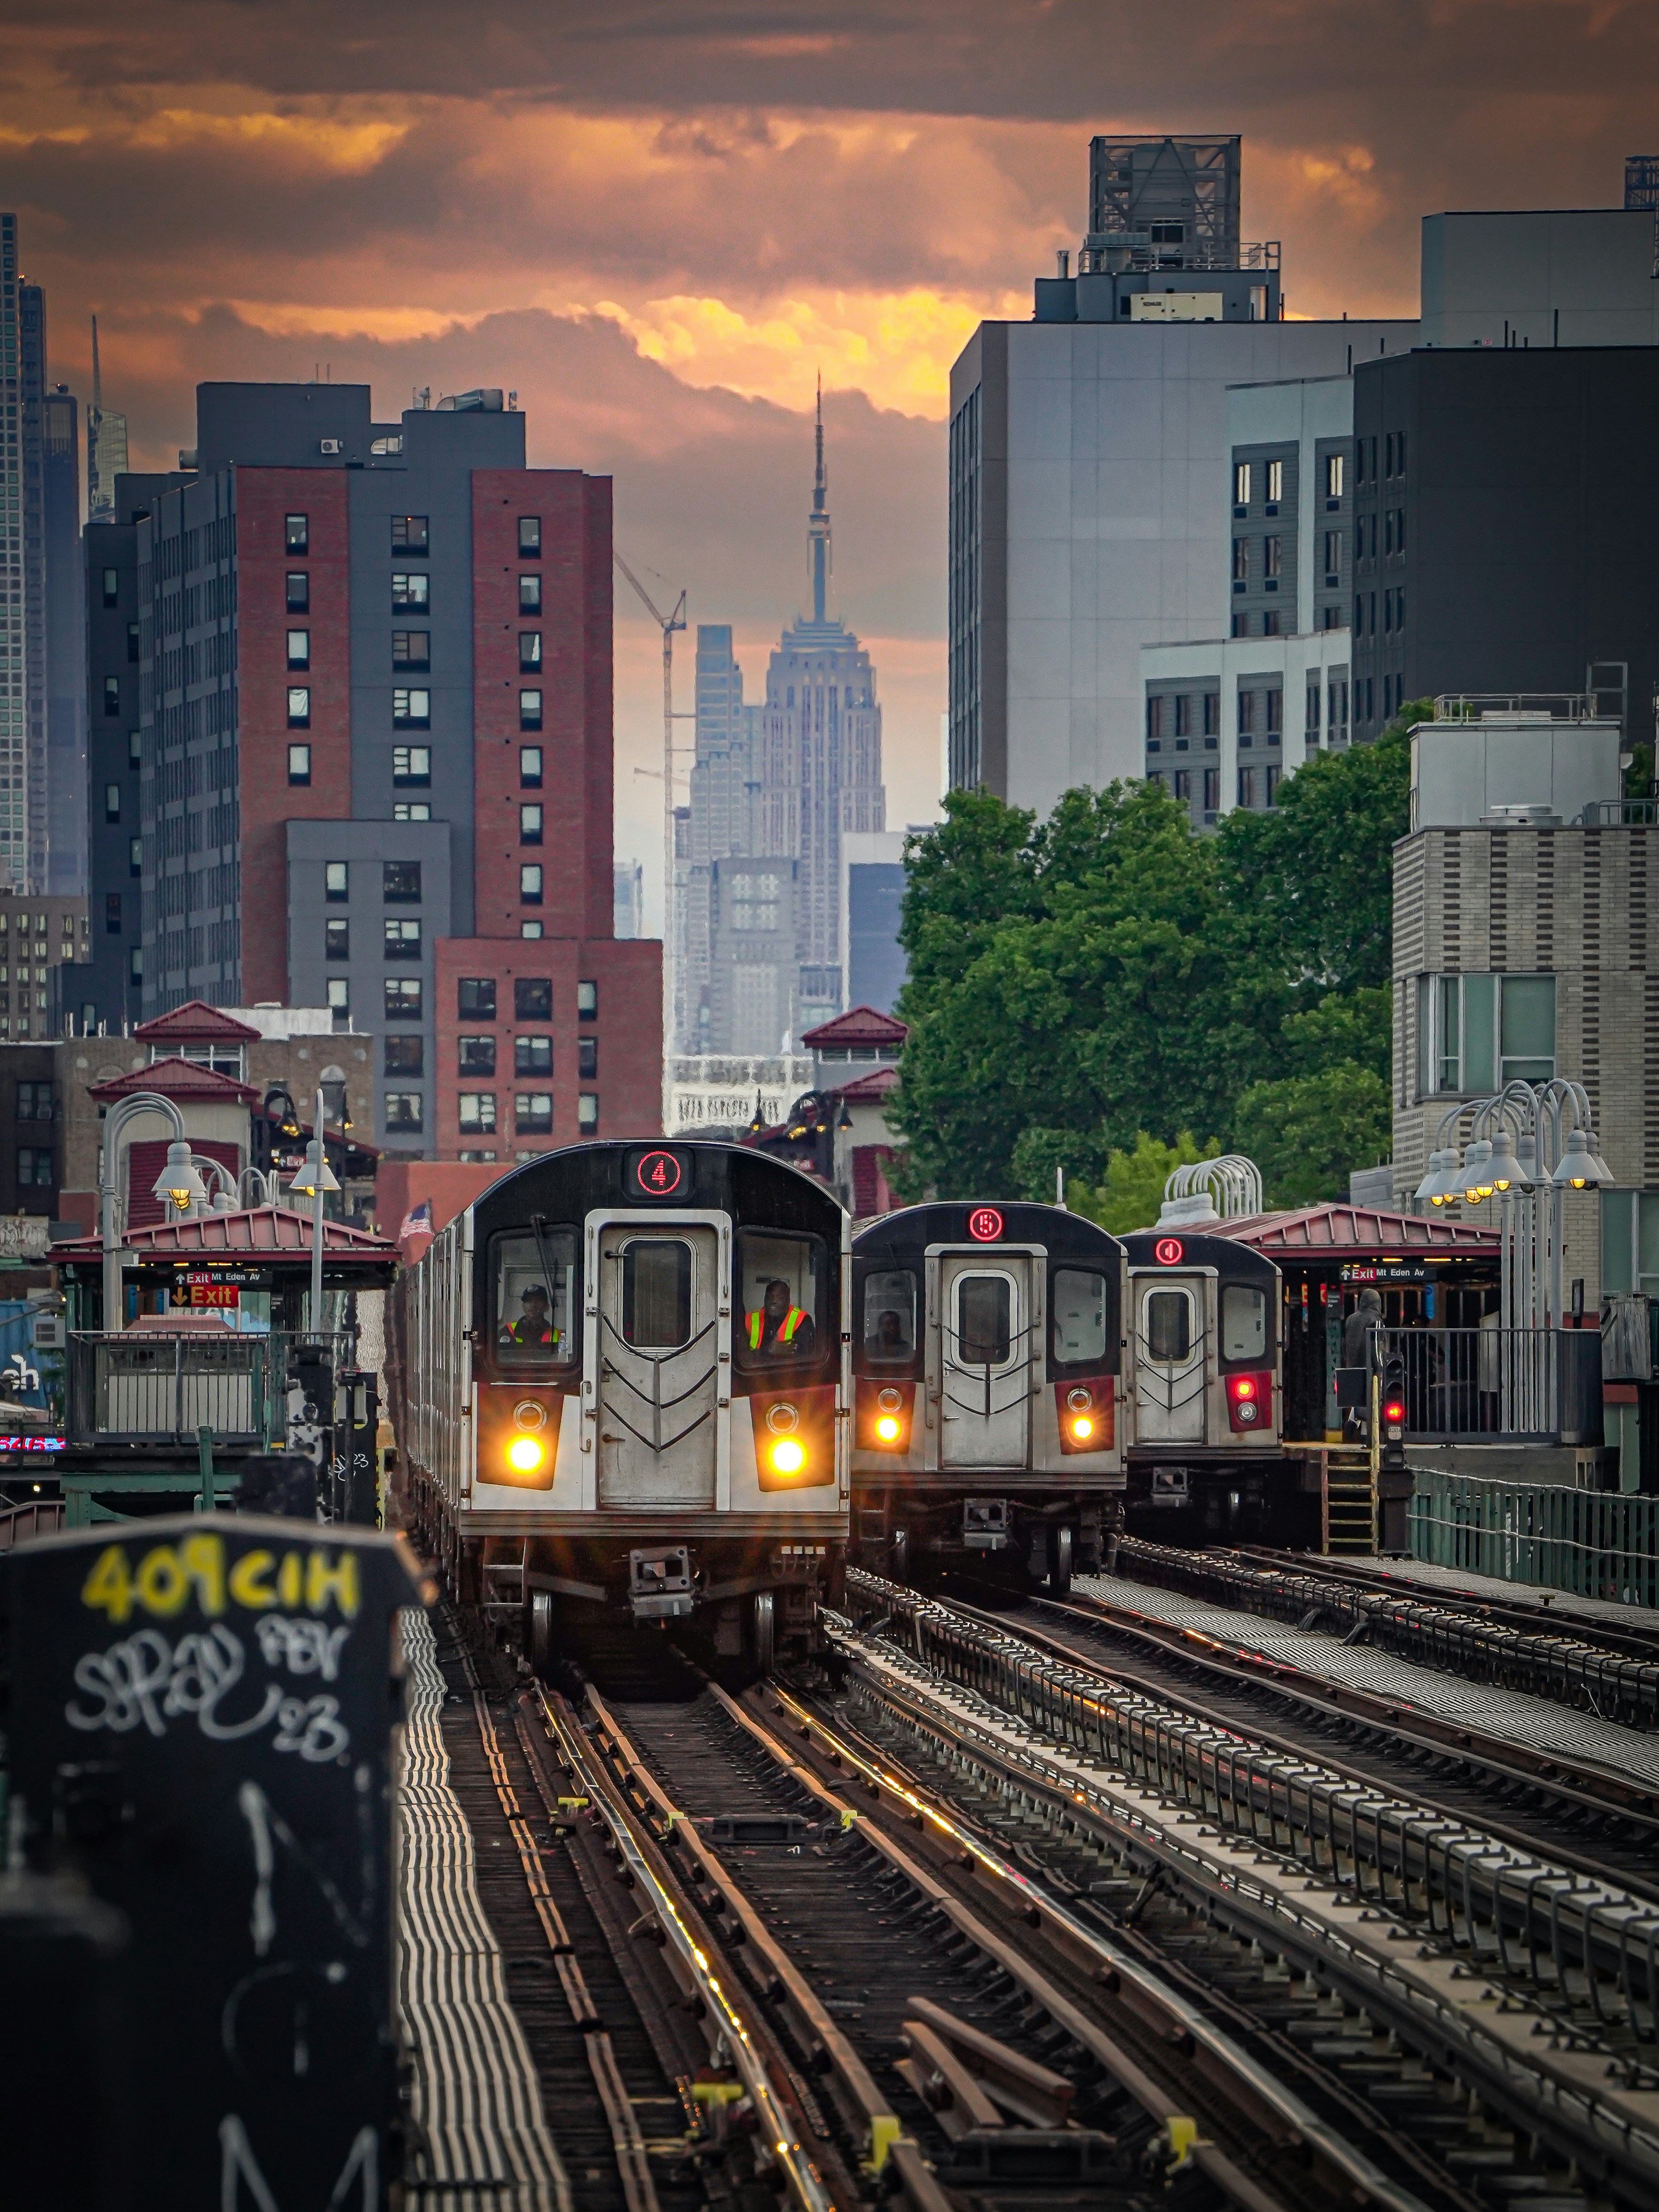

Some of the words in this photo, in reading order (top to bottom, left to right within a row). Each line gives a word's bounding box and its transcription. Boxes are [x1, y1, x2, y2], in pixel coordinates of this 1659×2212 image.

[652, 1159, 666, 1186] 4
[980, 1214, 993, 1235] 5
[187, 1273, 209, 1283] Exit
[1352, 1269, 1374, 1279] Exit
[191, 1286, 231, 1304] Exit
